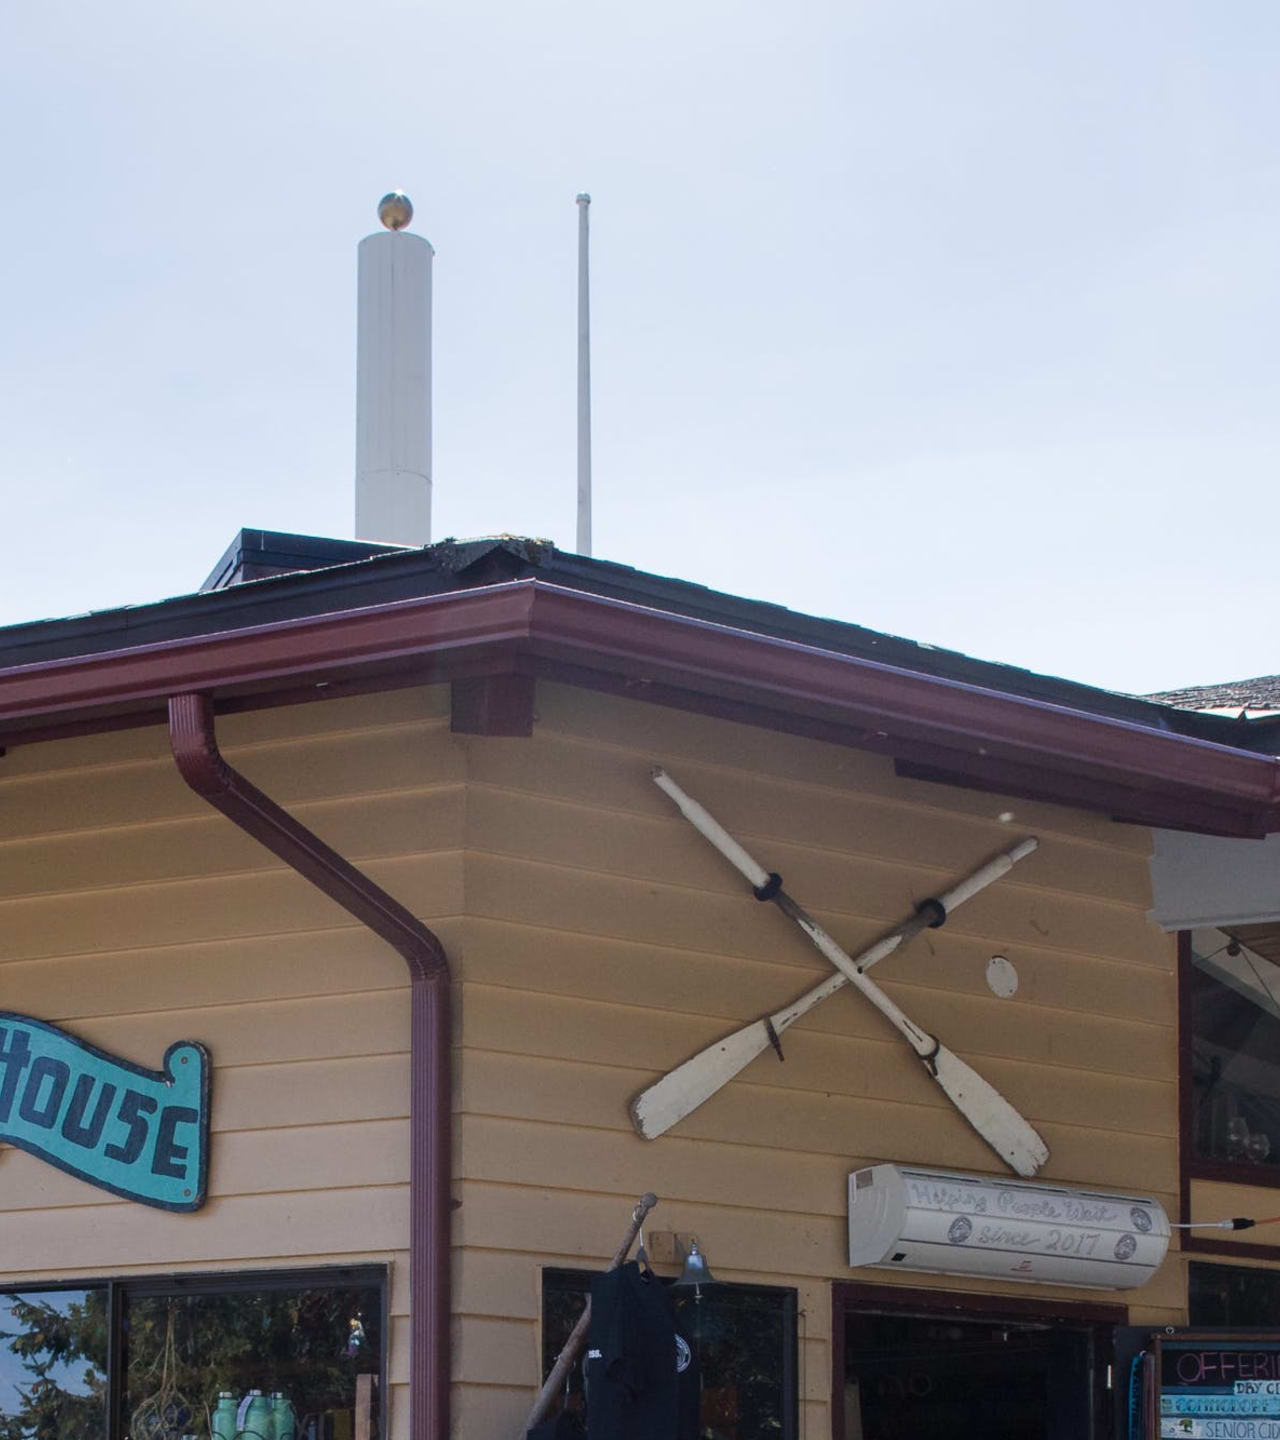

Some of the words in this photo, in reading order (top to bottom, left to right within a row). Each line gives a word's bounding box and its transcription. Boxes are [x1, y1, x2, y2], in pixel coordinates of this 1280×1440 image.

[1045, 1230, 1100, 1255] 2017
[1236, 1383, 1261, 1394] DRY
[1206, 1422, 1256, 1438] SENIOR
